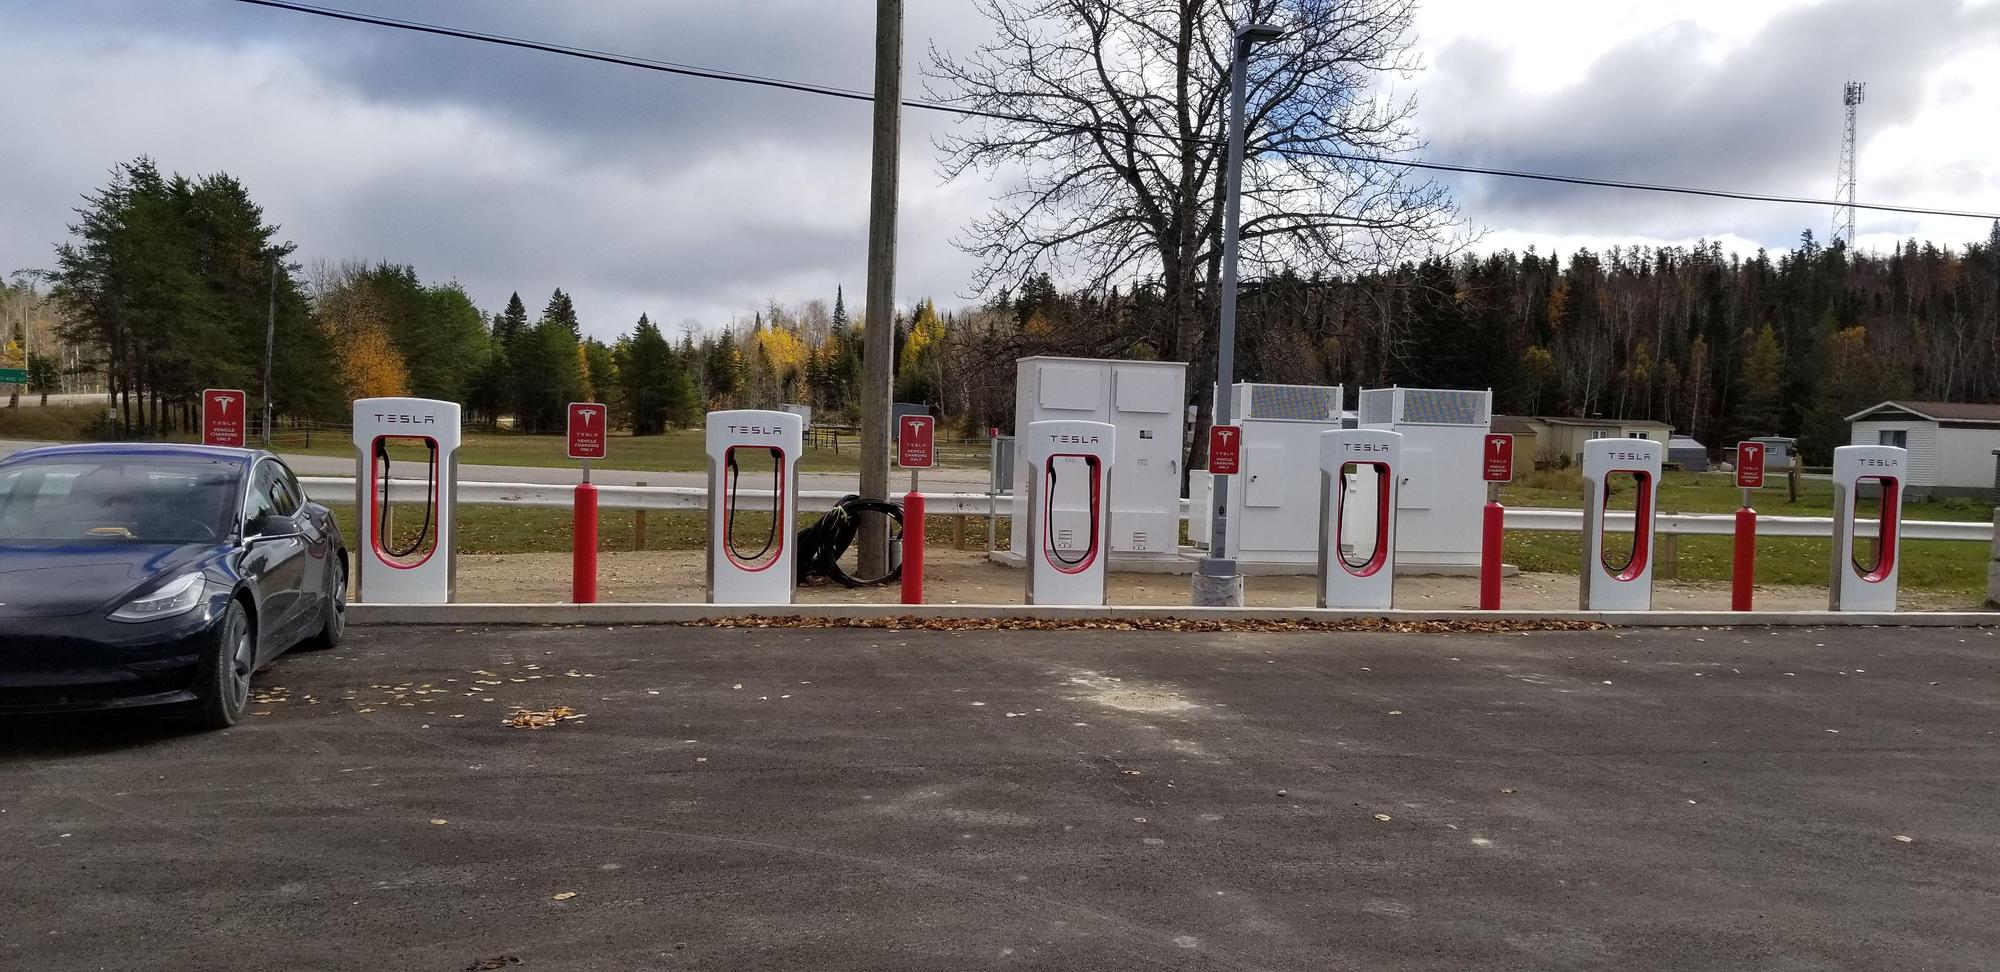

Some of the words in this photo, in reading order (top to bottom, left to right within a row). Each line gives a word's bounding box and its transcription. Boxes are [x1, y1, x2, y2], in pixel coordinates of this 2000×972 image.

[374, 414, 434, 424] TESLA
[728, 425, 782, 435] TESLA
[1050, 435, 1099, 444] TESLA
[1344, 443, 1389, 452] TESLA
[1608, 452, 1651, 461] TESLA
[1859, 459, 1898, 467] TESLA
